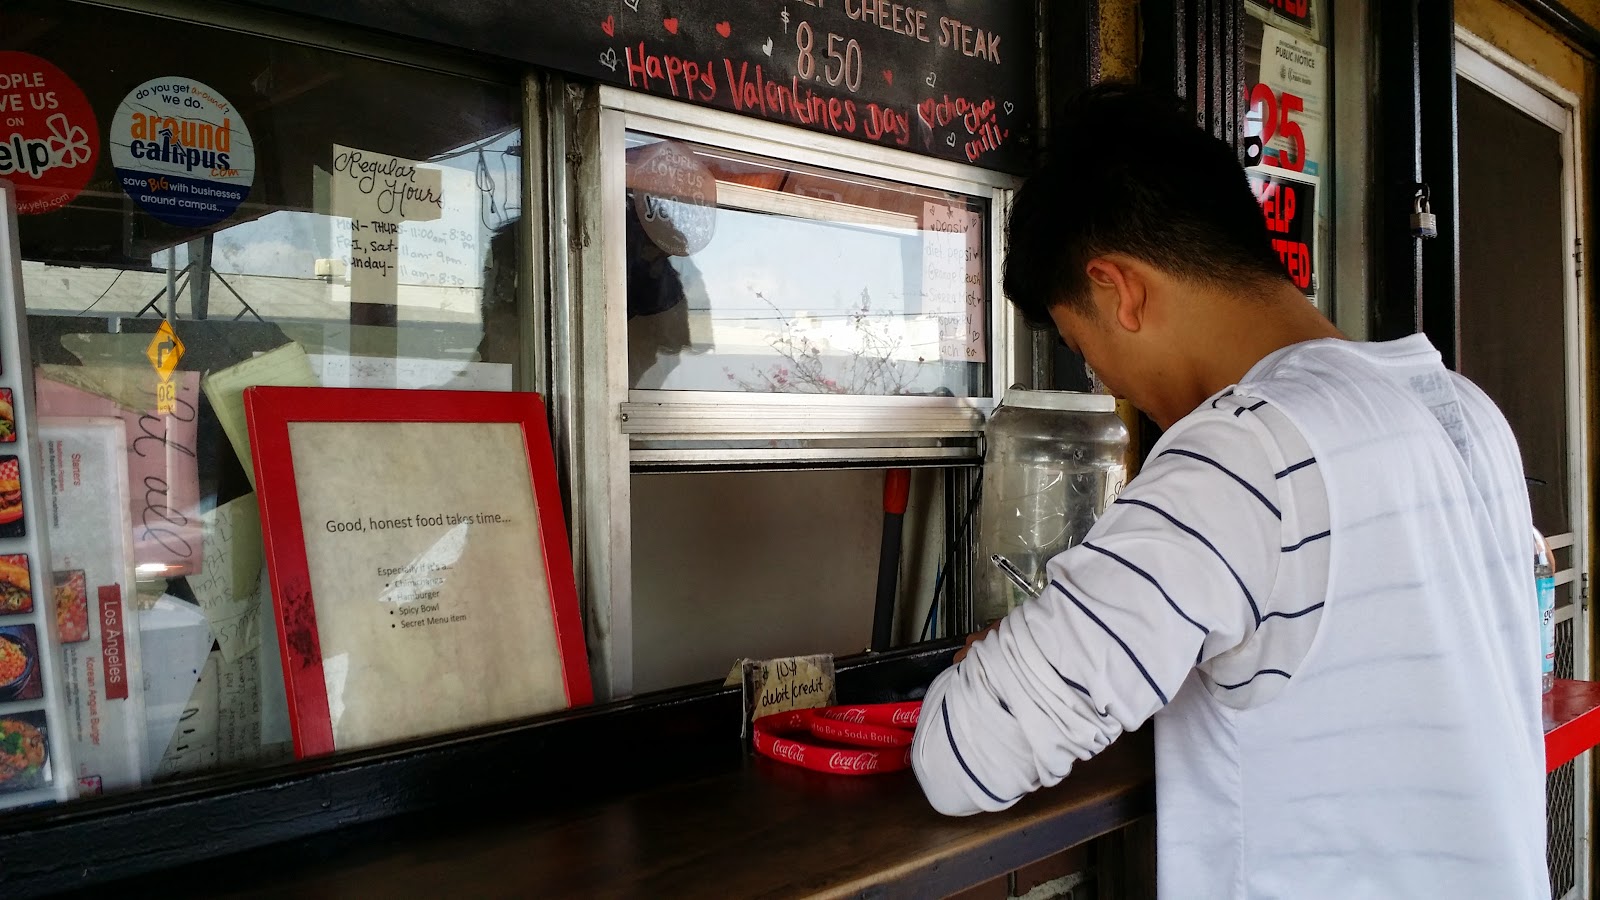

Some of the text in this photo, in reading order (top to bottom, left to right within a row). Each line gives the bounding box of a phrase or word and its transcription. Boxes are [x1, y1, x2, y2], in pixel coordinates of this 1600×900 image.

[845, 0, 1001, 65] CHEESE STEAK
[1275, 46, 1315, 69] PUBLIC NOTICE
[0, 72, 45, 89] OPLE
[136, 88, 150, 100] do
[151, 83, 170, 96] you
[172, 82, 190, 94] get
[0, 91, 59, 113] VE US
[162, 93, 204, 110] we do.
[625, 41, 910, 145] Happy Valentines Day
[6, 117, 25, 128] ON
[130, 112, 231, 153] around
[0, 136, 50, 176] elp
[208, 167, 239, 178] .com
[334, 151, 416, 194] Regular
[651, 160, 704, 188] LOVE US
[123, 176, 147, 188] save
[169, 181, 189, 193] with
[190, 185, 241, 200] businesses
[141, 193, 176, 206] around
[16, 193, 70, 212] w.yelp.com
[1261, 182, 1296, 233] ELP
[1271, 238, 1311, 289] TED
[72, 453, 81, 487] Starters
[326, 511, 511, 534] Good, honest food takes time...
[377, 563, 419, 577] Especially
[396, 590, 440, 602] Hamburger
[399, 603, 440, 617] Spicy Bowl
[401, 613, 467, 629] Secret Menu item
[104, 601, 121, 684] Los Angeles
[86, 656, 96, 687] Korean
[87, 689, 98, 715] Angus
[816, 724, 824, 733] to
[825, 725, 836, 736] Be
[837, 729, 843, 737] a
[844, 729, 868, 741] Soda
